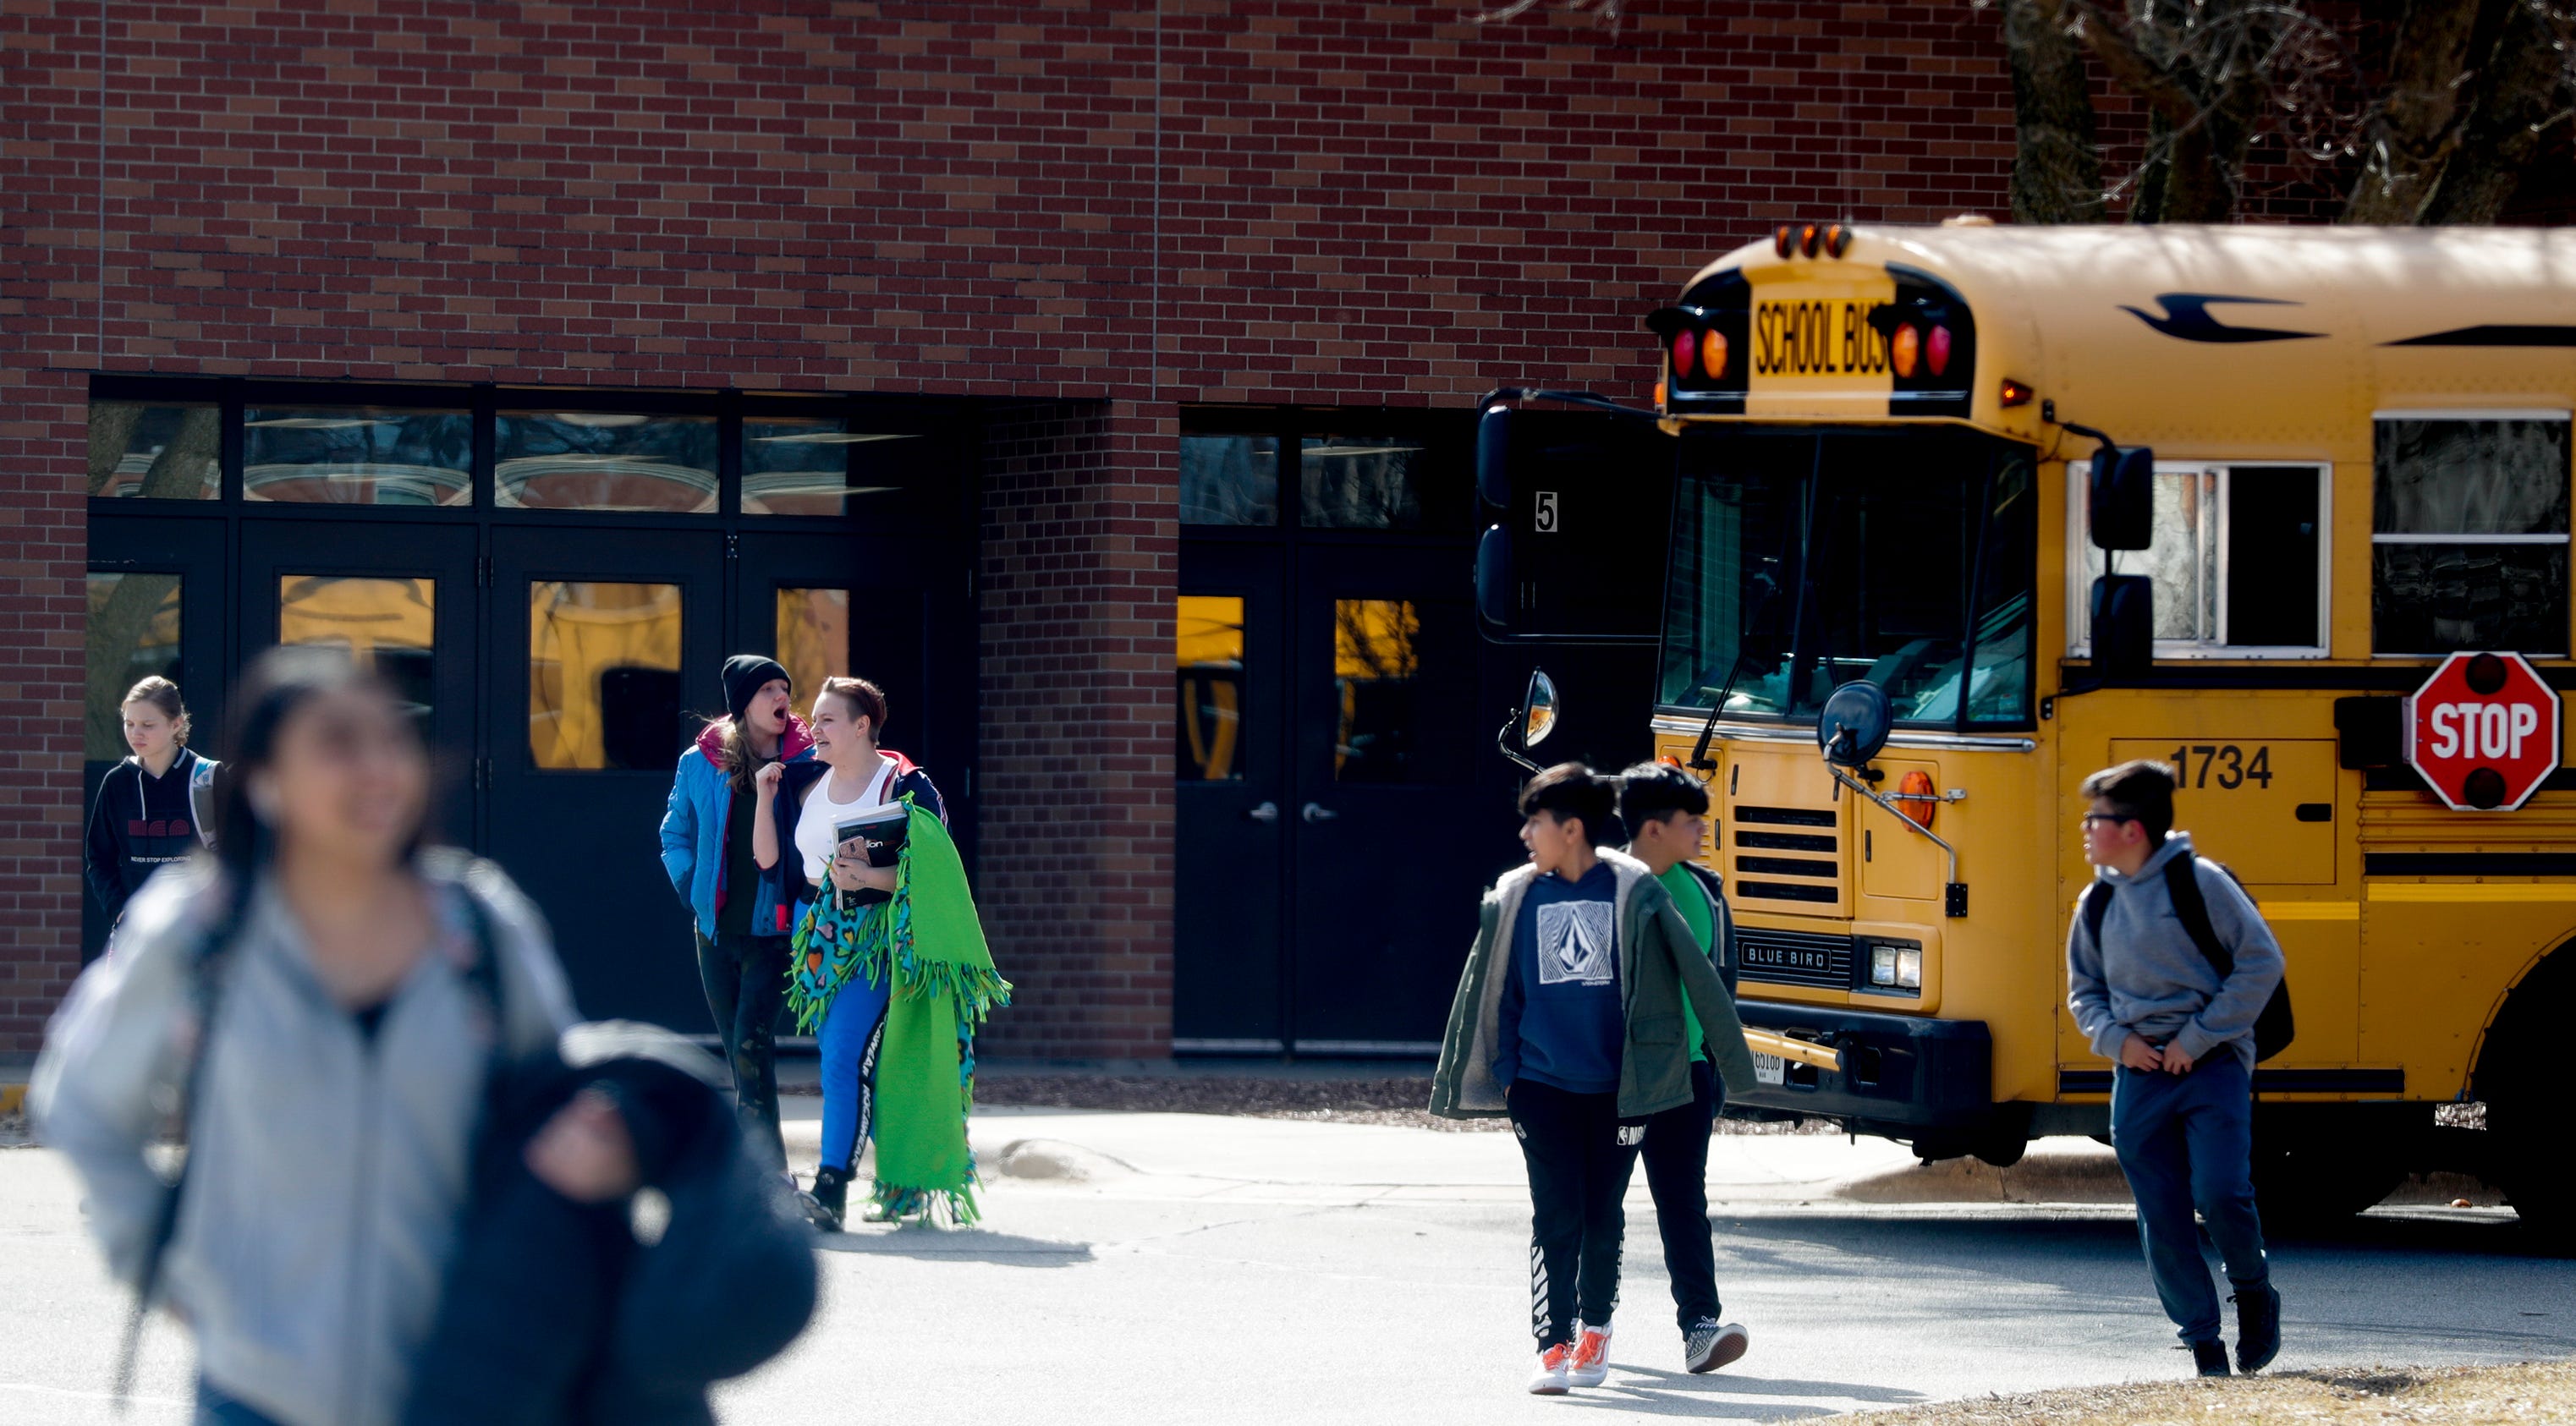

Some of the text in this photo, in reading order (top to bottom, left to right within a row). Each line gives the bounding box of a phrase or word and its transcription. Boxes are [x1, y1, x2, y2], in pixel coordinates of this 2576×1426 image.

[1757, 302, 1887, 374] SCHOOL BUS
[1536, 493, 1554, 531] 5
[2430, 702, 2538, 760] STOP
[2170, 745, 2273, 789] 1734
[1749, 947, 1824, 967] BLUE BIRD
